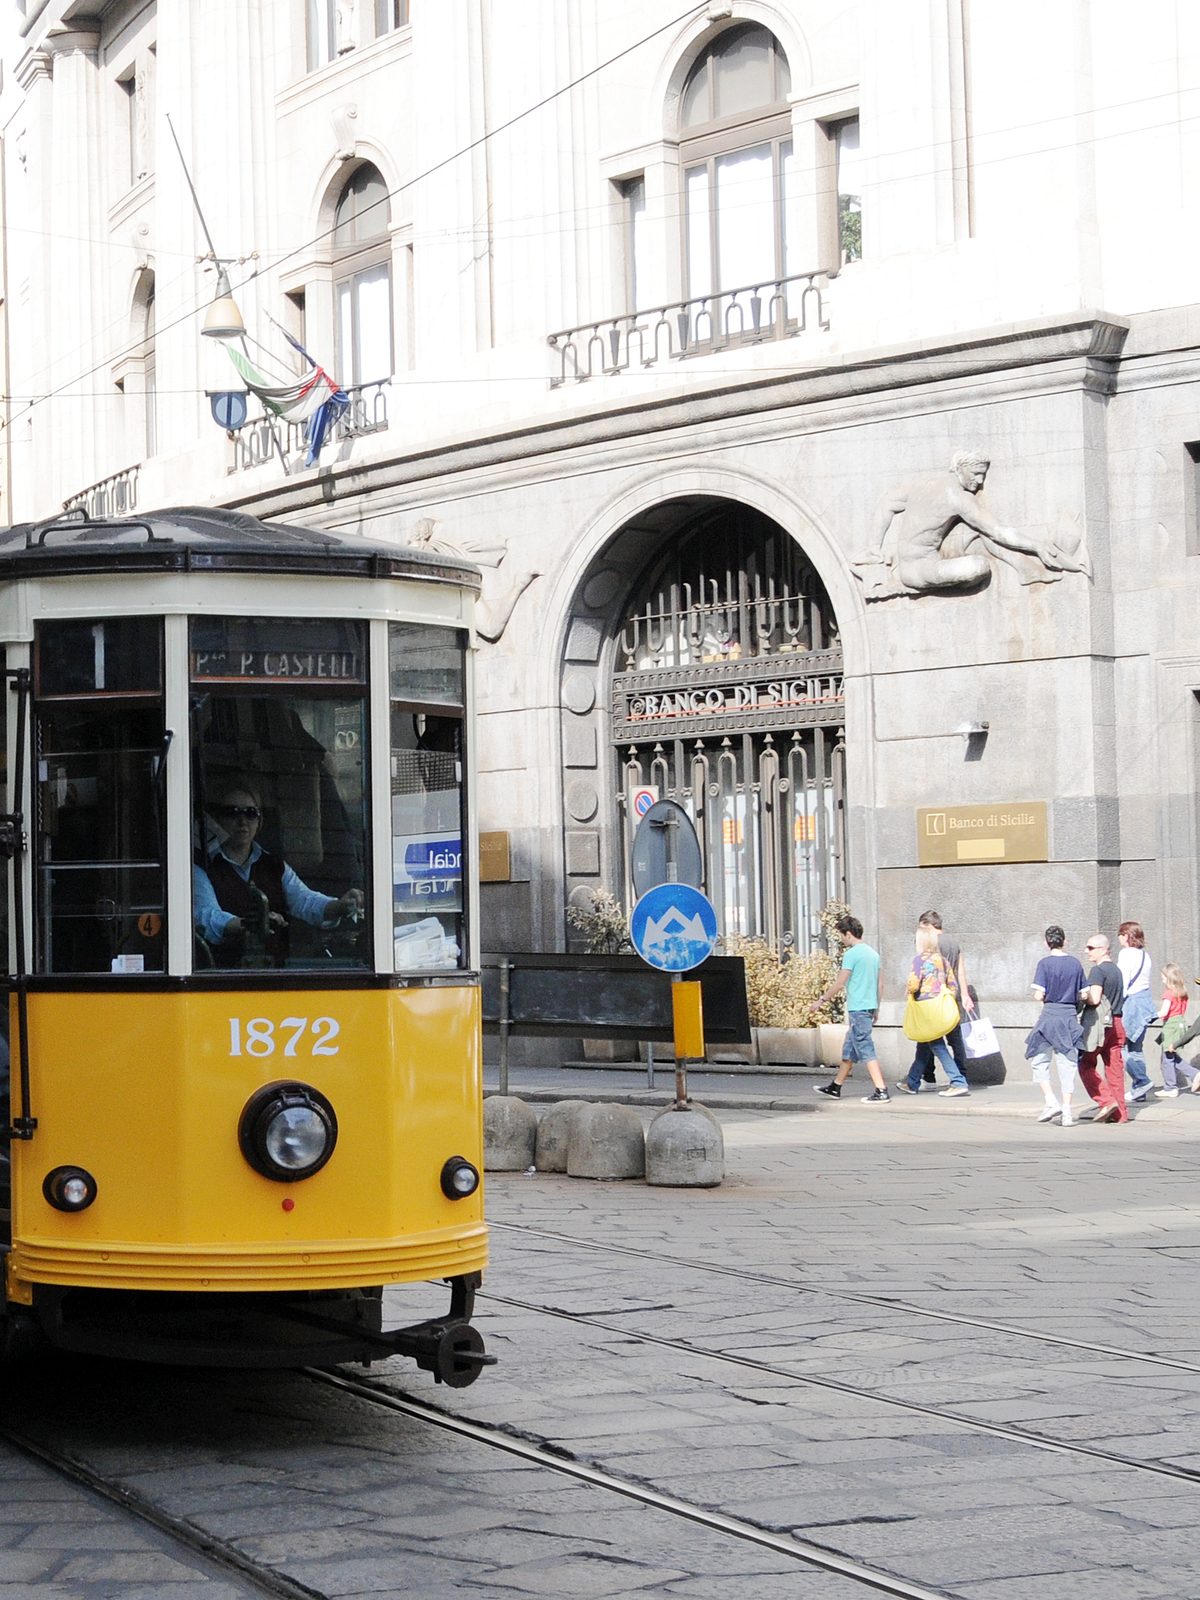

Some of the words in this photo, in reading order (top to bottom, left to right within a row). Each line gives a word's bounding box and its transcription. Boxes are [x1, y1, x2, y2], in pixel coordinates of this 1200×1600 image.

[91, 624, 105, 689] 1
[645, 689, 724, 717] BANCO
[734, 686, 757, 710] DI
[949, 816, 984, 829] Banco
[986, 814, 998, 827] di
[1000, 813, 1036, 826] Sicilia
[143, 915, 154, 935] 4
[228, 1017, 340, 1057] 1872
